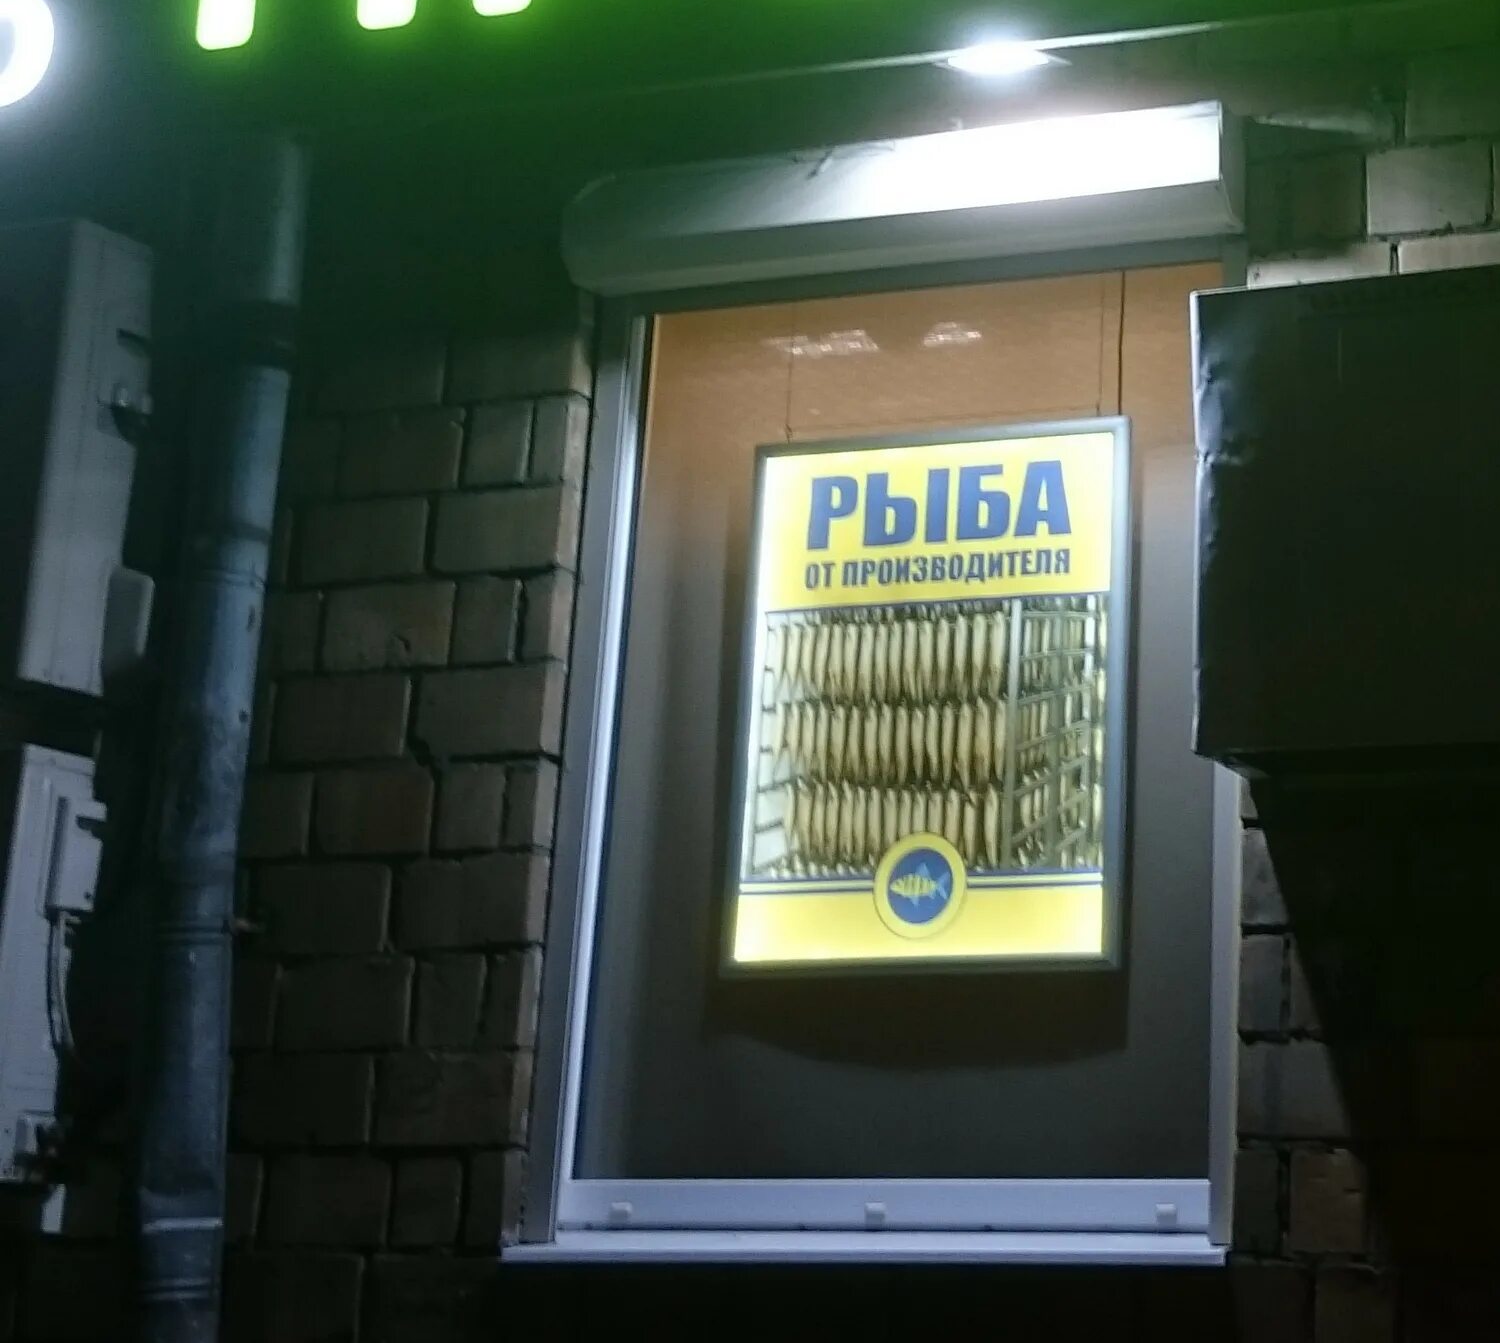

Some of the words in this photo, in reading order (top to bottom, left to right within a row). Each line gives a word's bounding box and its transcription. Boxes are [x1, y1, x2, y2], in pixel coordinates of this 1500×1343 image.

[806, 459, 1073, 551] РЫБА
[804, 560, 834, 591] ОТ
[841, 547, 1071, 589] ПРОИЗВОДИТЕЛЯ
